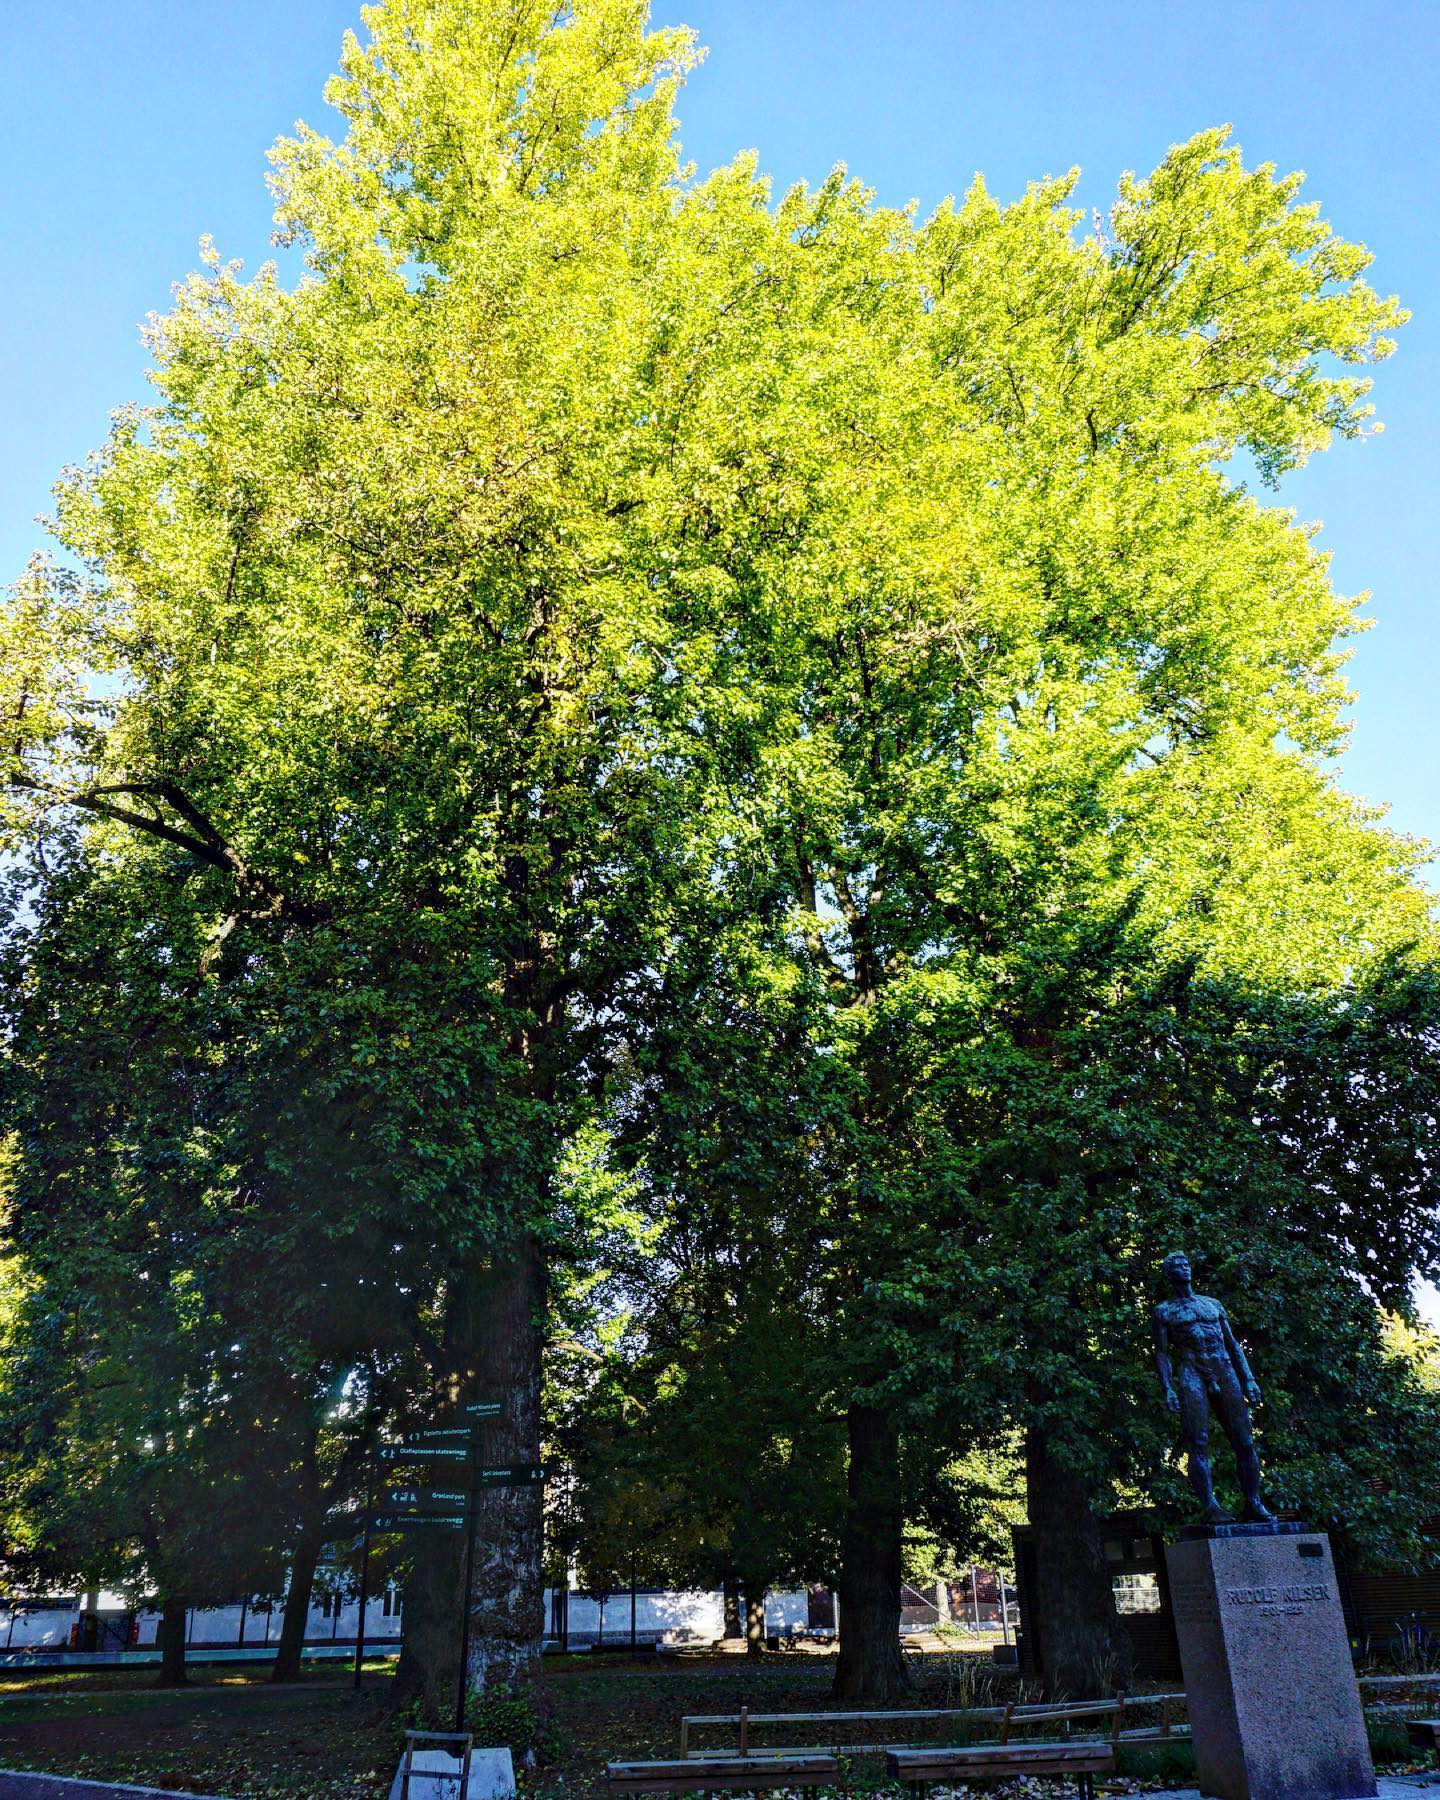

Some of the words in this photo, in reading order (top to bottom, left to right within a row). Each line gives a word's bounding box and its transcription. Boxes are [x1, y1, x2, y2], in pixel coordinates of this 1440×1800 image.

[455, 1493, 465, 1501] park
[1225, 1587, 1278, 1605] RUDOLF
[1282, 1583, 1331, 1602] NILSEN
